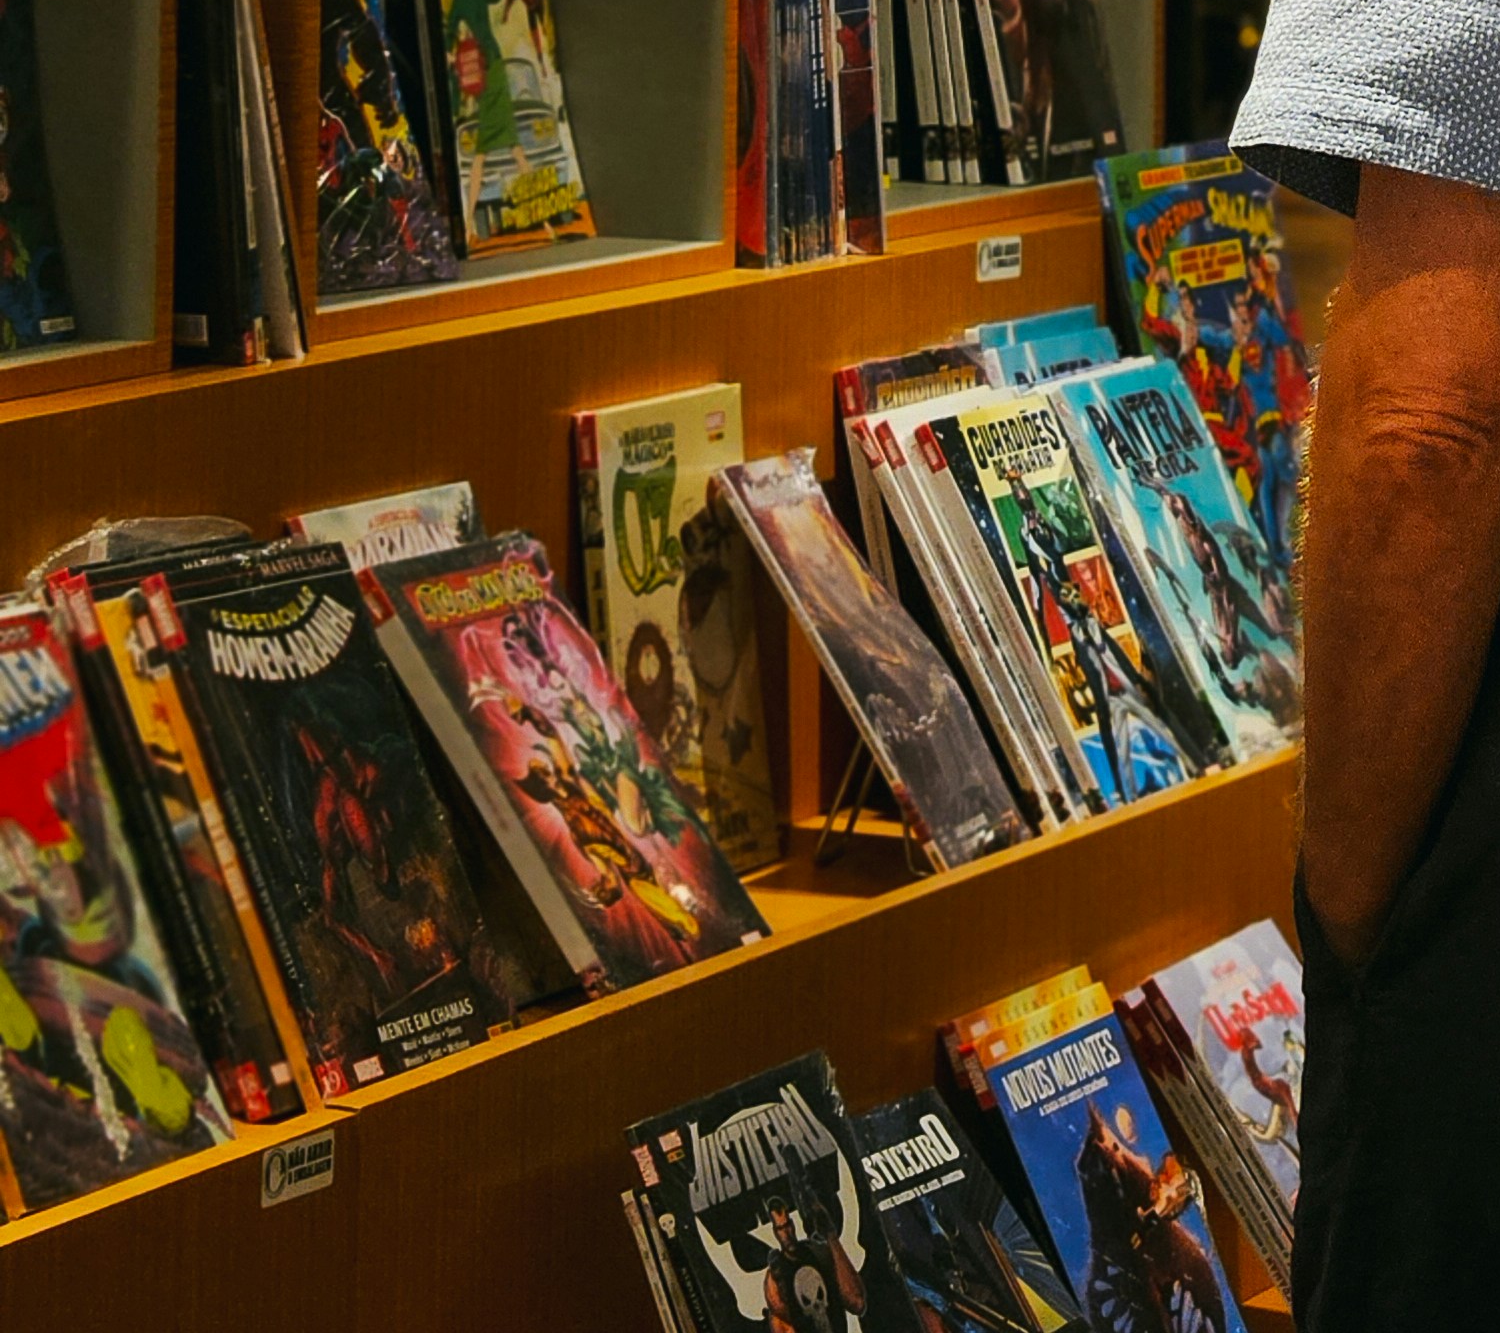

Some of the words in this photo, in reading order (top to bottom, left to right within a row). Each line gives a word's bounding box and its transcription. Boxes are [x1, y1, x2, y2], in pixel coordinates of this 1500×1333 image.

[967, 409, 1060, 470] GUARDIÕES
[1086, 389, 1203, 470] PANTERA
[259, 558, 306, 576] MARVEL
[309, 551, 340, 571] SAGA
[207, 595, 356, 681] HOMEM-ARANHA
[219, 585, 318, 631] ESPETACULAR
[377, 1014, 415, 1043] MENTE
[415, 1010, 431, 1031] EM
[430, 997, 474, 1025] CHAMAS
[1001, 1058, 1056, 1112] NOVOS
[1047, 1028, 1122, 1091] MUTANTES
[687, 1083, 838, 1214] JUSTICEIRO
[861, 1113, 960, 1192] STICEIRO
